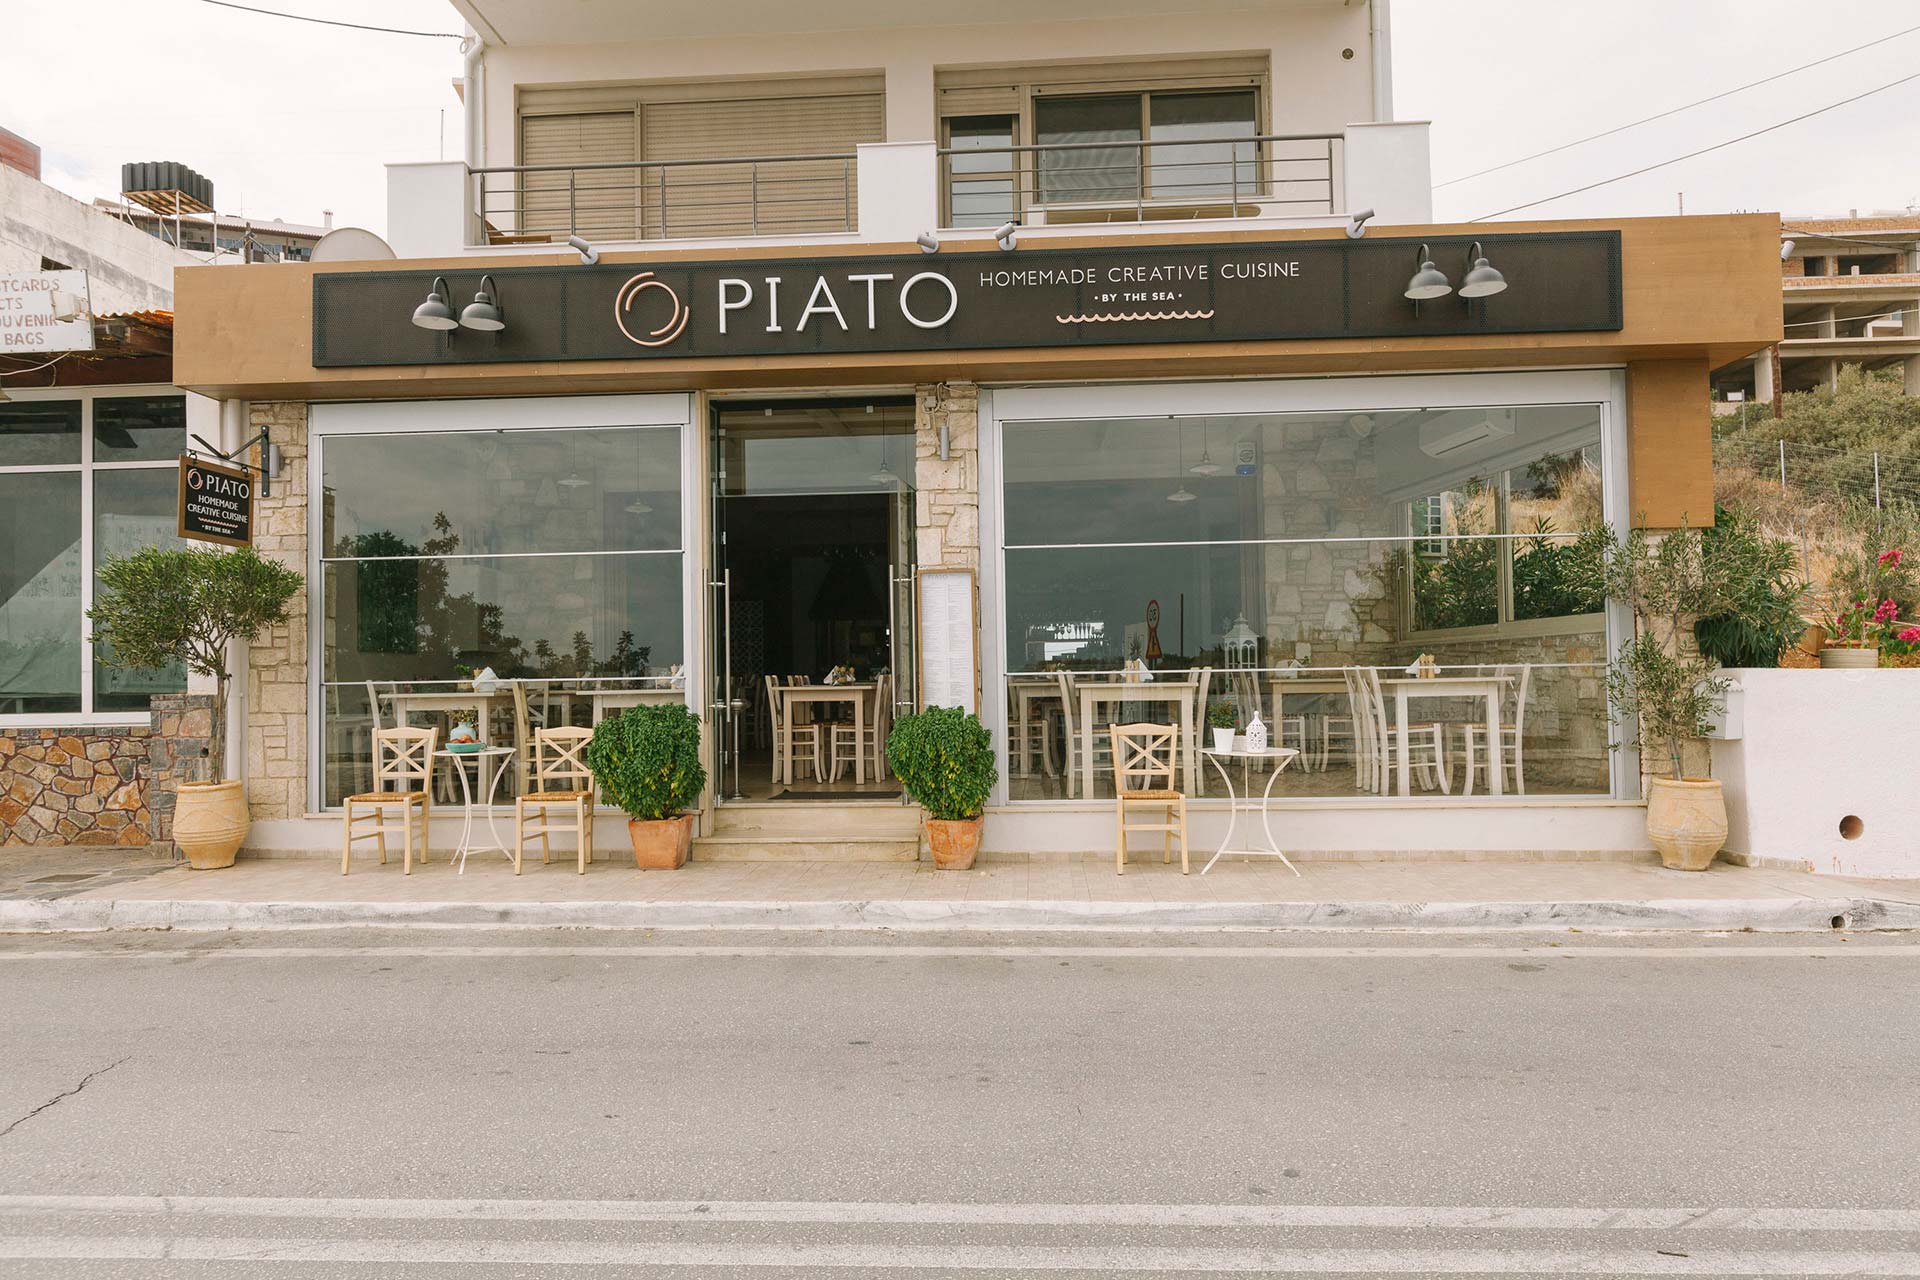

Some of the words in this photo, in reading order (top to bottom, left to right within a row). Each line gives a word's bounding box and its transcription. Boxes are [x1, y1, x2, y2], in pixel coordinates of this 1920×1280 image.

[979, 267, 1097, 288] HOMEMADE
[1107, 264, 1209, 284] CREATIVE
[1220, 261, 1300, 280] CUISINE
[0, 278, 60, 291] TCARDS
[718, 271, 958, 334] PIATO
[1123, 292, 1147, 302] THE
[0, 314, 58, 328] UVENIR
[4, 332, 44, 346] BAGS
[206, 474, 250, 499] PIATO
[198, 494, 239, 511] HOMEMADE
[187, 503, 220, 517] CREATIVE
[222, 511, 248, 523] CUISINE
